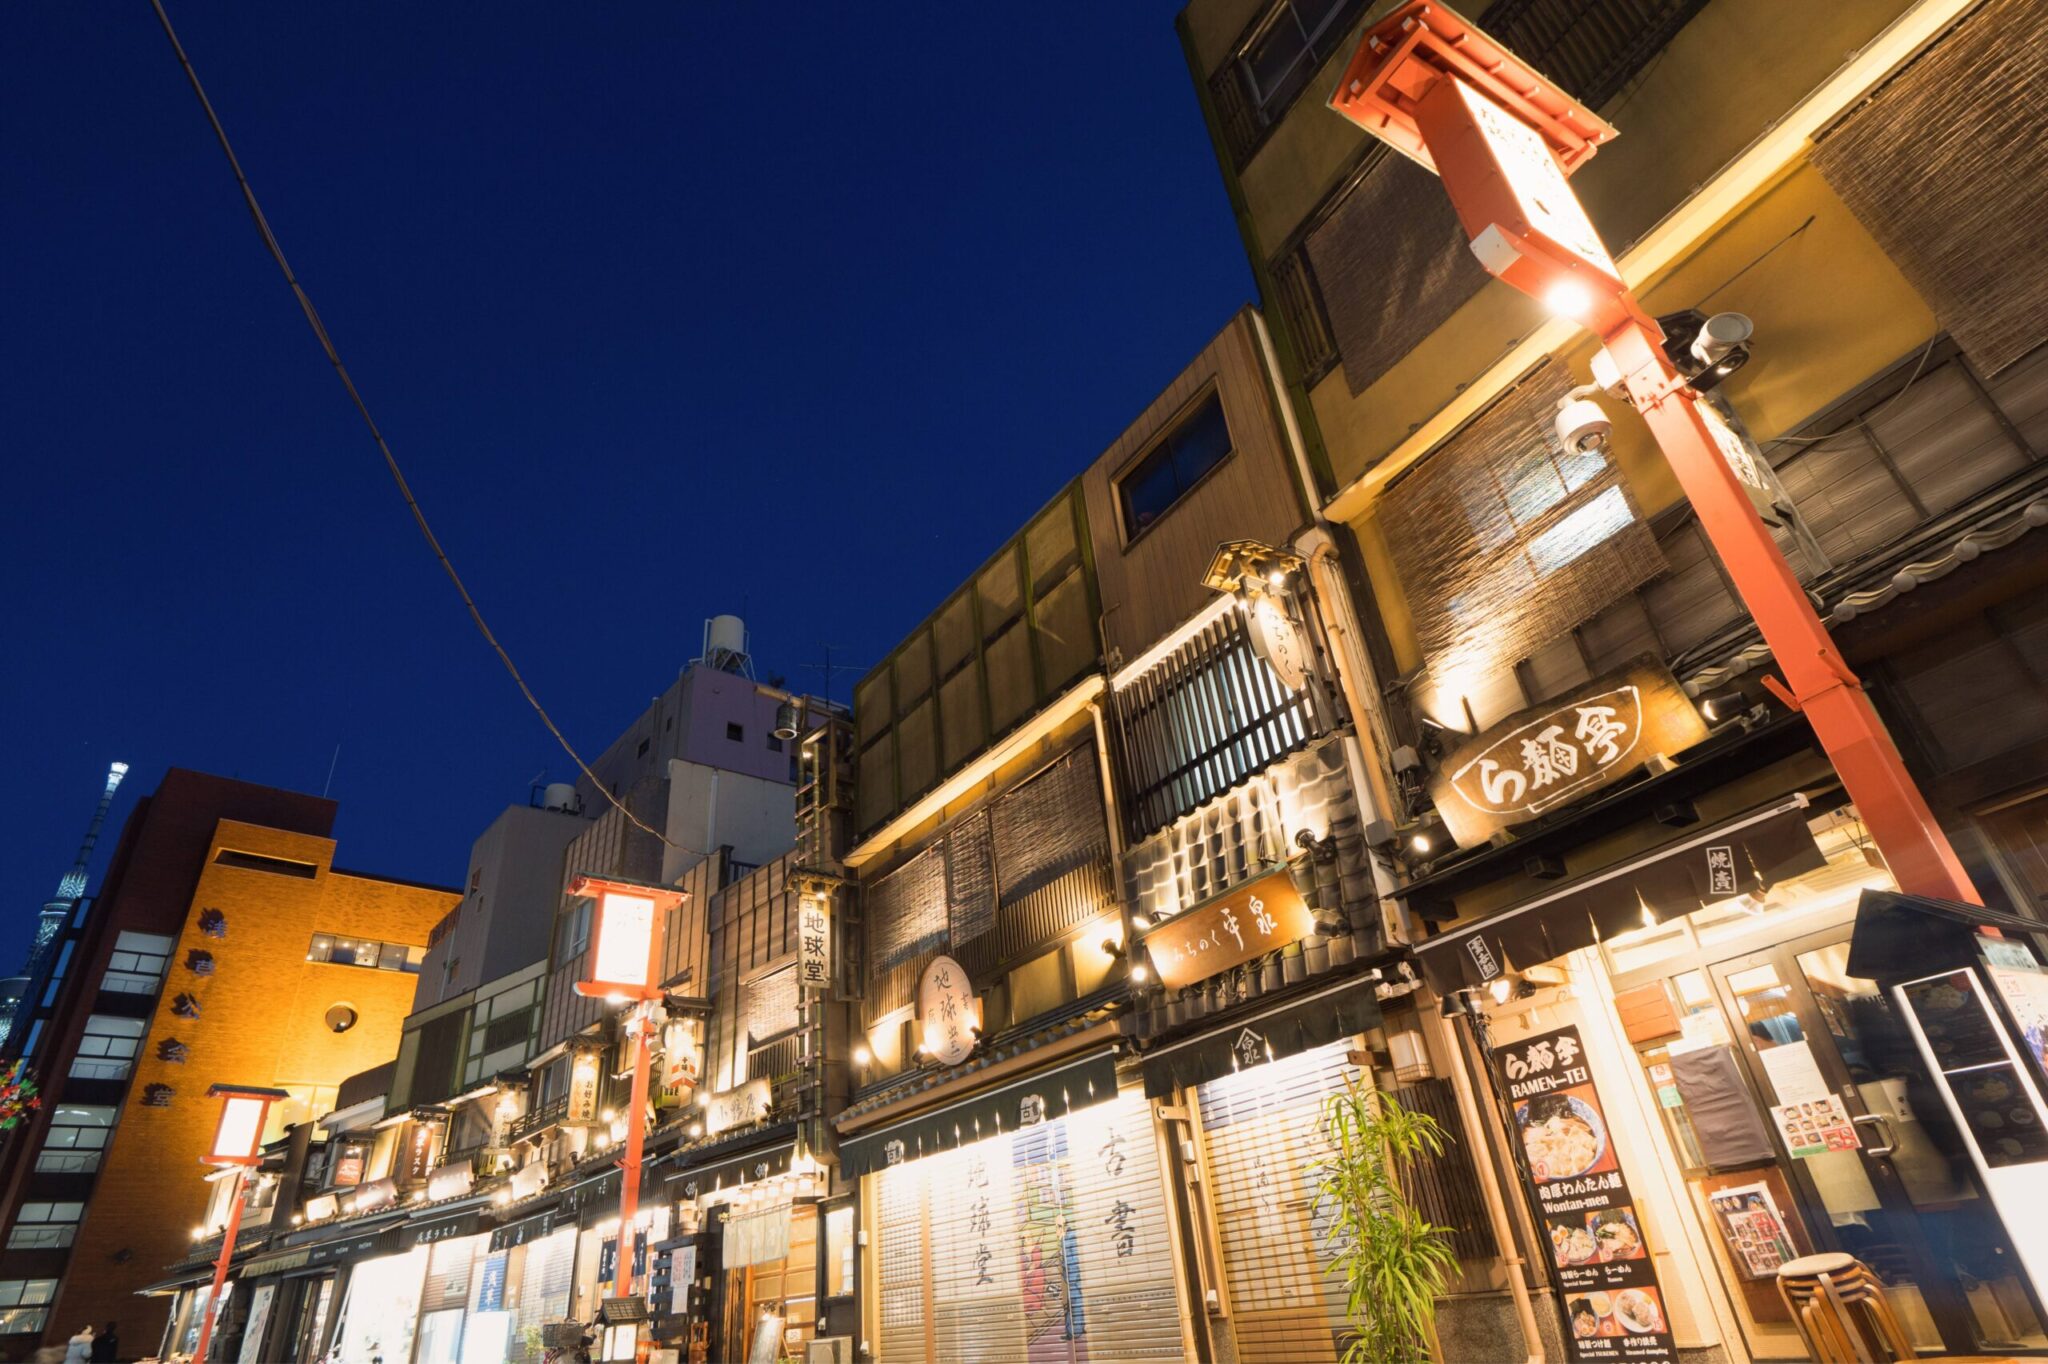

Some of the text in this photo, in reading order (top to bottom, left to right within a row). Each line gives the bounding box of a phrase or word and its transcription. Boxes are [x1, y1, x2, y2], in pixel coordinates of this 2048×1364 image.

[804, 912, 825, 982] 地球堂
[934, 967, 961, 1056] 地球堂
[1542, 1195, 1609, 1214] Wontan-men
[1605, 1264, 1632, 1275] らーめん
